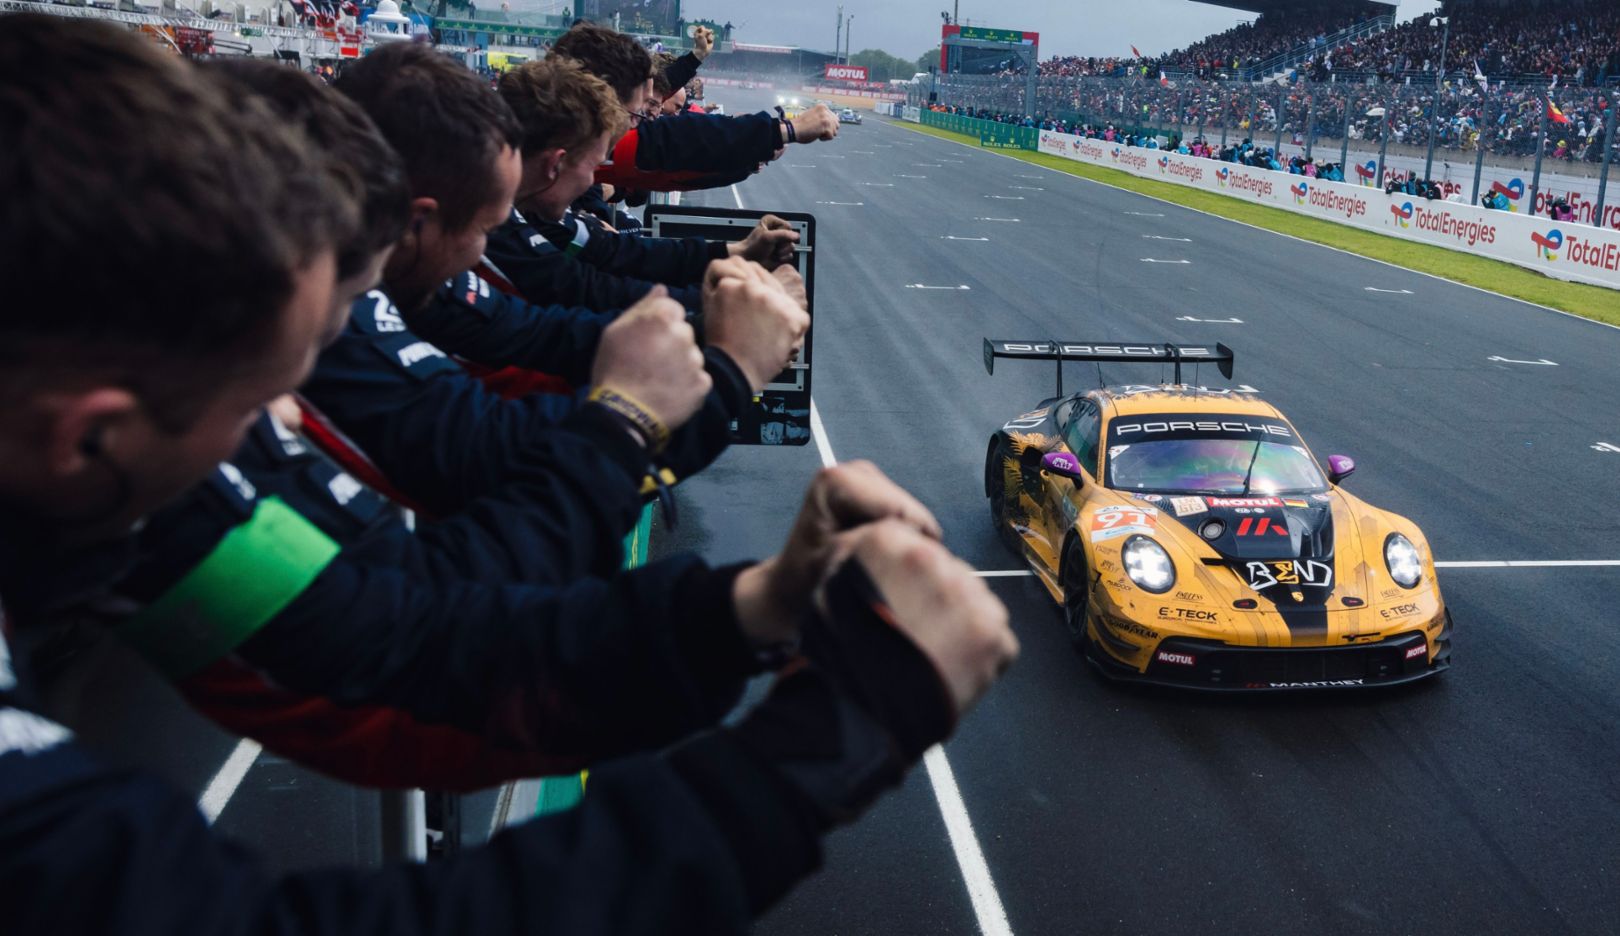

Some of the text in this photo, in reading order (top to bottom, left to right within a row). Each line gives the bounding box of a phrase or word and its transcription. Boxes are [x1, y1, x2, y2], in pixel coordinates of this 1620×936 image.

[827, 68, 865, 79] MOTUL
[1119, 150, 1148, 170] TotalEnergies
[1167, 159, 1203, 182] TotalEnergies
[1229, 170, 1273, 197] TotalEnergies
[1309, 186, 1366, 218] TotalEnergies
[1415, 207, 1497, 246] TotalEnergies
[1004, 343, 1210, 355] PORSCHE
[1116, 421, 1291, 437] PORSCHE
[1213, 498, 1280, 506] MOTUL
[1097, 511, 1152, 529] 91
[1159, 652, 1193, 664] MOTUL
[1406, 644, 1427, 659] MOTUL
[1270, 679, 1363, 688] MANTHEY
